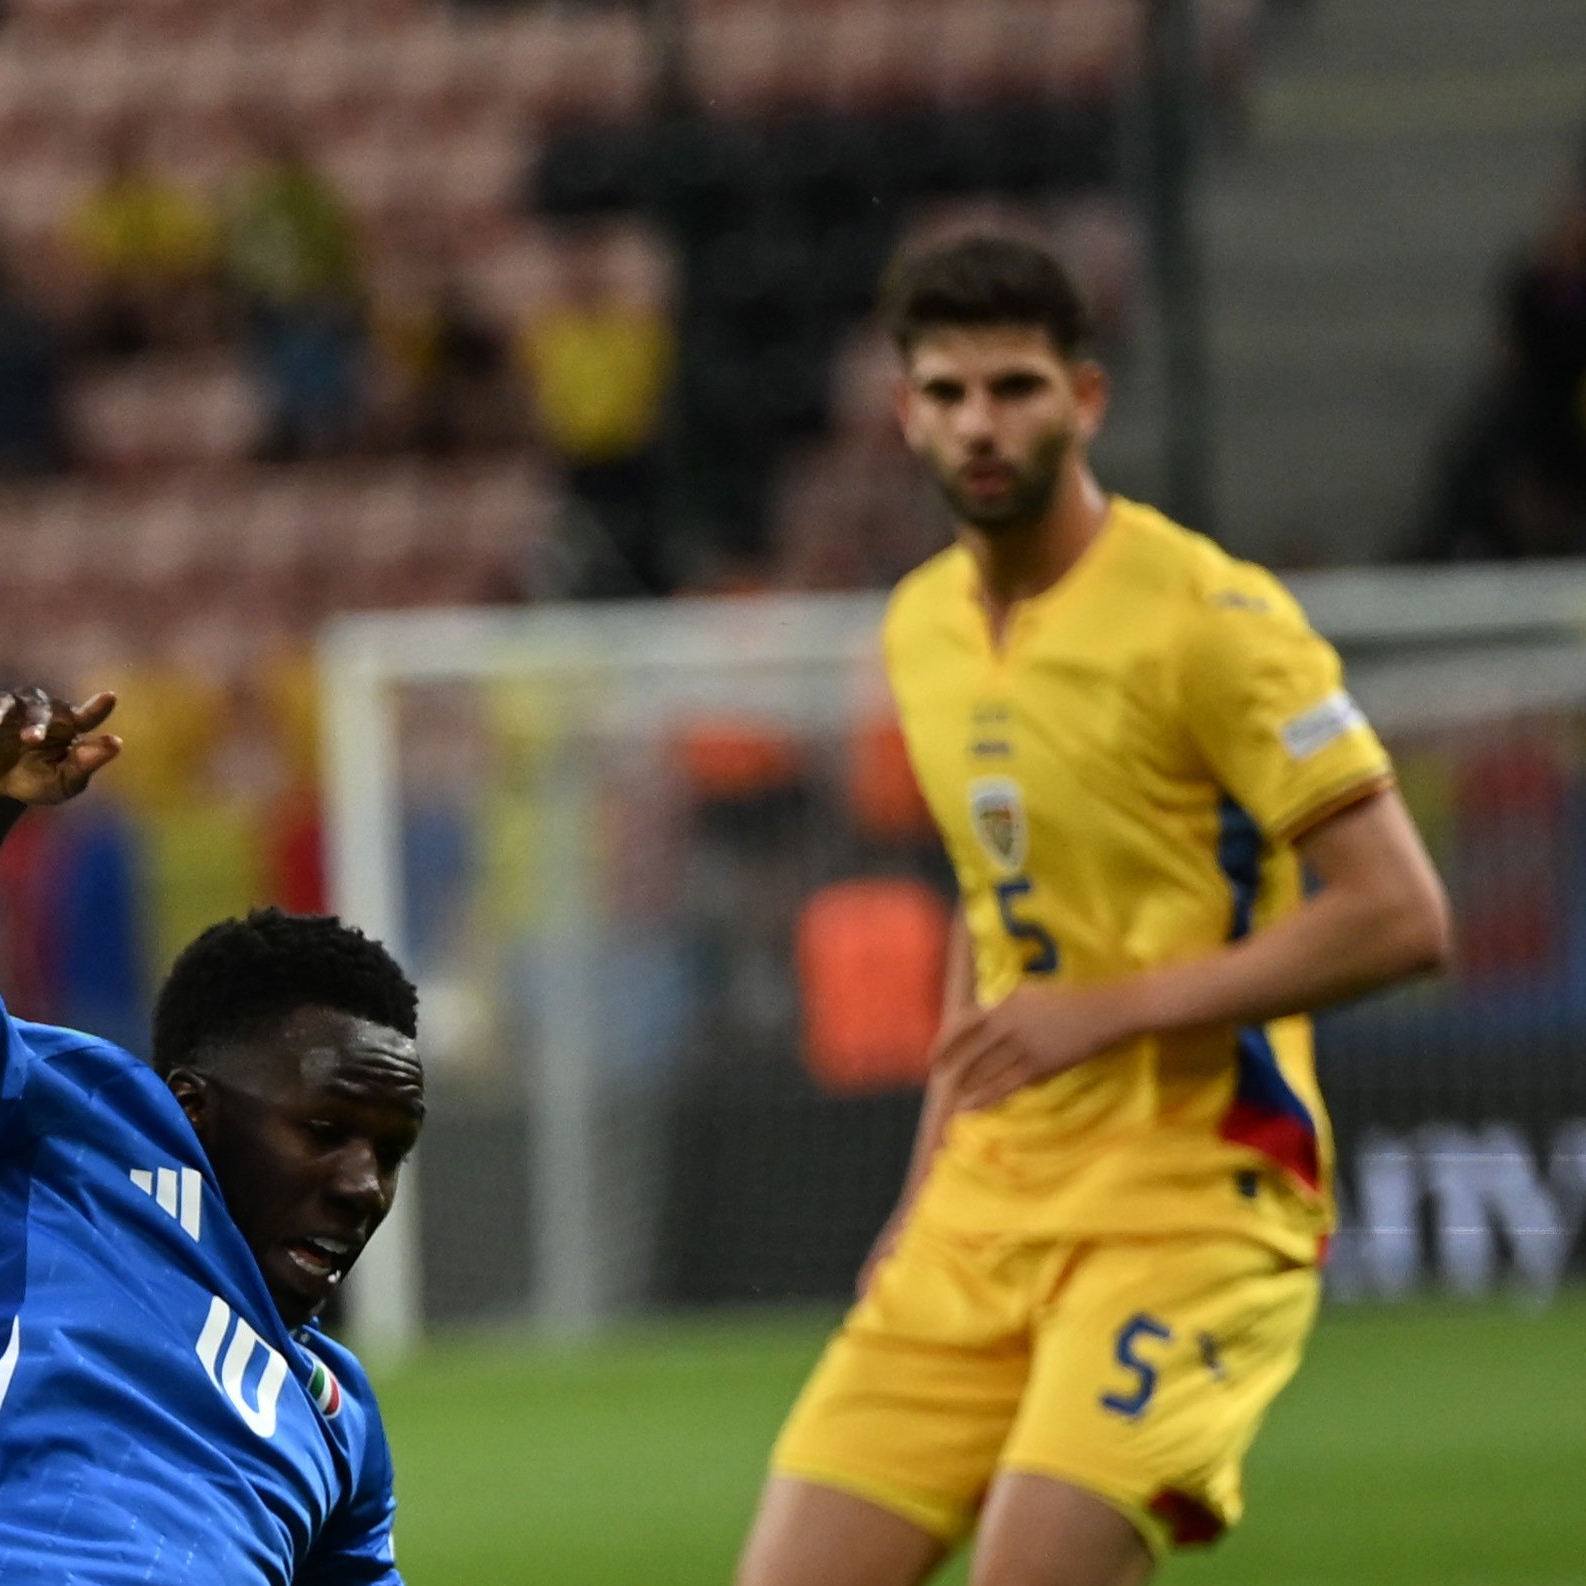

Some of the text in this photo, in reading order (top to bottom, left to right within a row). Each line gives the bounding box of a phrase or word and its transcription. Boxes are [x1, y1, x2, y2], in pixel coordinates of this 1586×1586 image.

[995, 878, 1059, 976] 5
[195, 1294, 288, 1439] 10
[1099, 1313, 1173, 1417] 5
